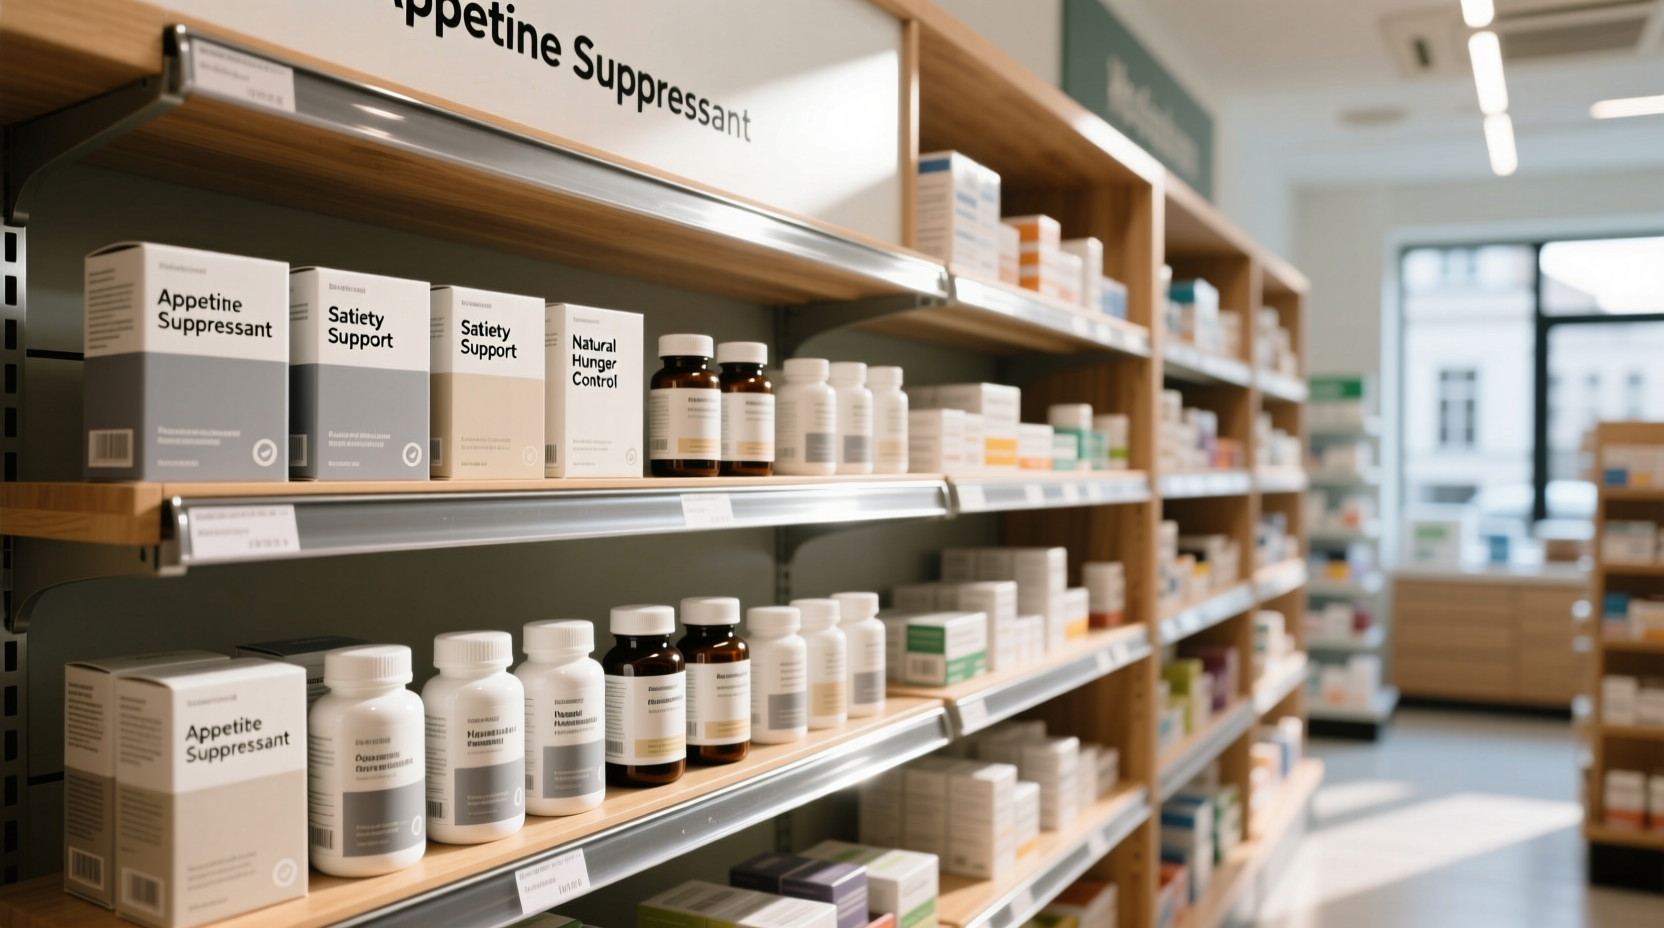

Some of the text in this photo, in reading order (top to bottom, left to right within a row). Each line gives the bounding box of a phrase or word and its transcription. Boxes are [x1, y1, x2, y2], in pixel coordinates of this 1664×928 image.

[394, 0, 752, 142] ppetine Suppressant
[157, 311, 273, 338] Suppressant
[328, 305, 385, 331] Satiety
[328, 327, 394, 350] Support
[461, 319, 511, 342] Satiety
[460, 339, 518, 360] Support
[572, 334, 617, 353] Natural
[572, 354, 618, 373] Hunger
[572, 371, 618, 389] Control
[185, 730, 291, 764] Suppressant
